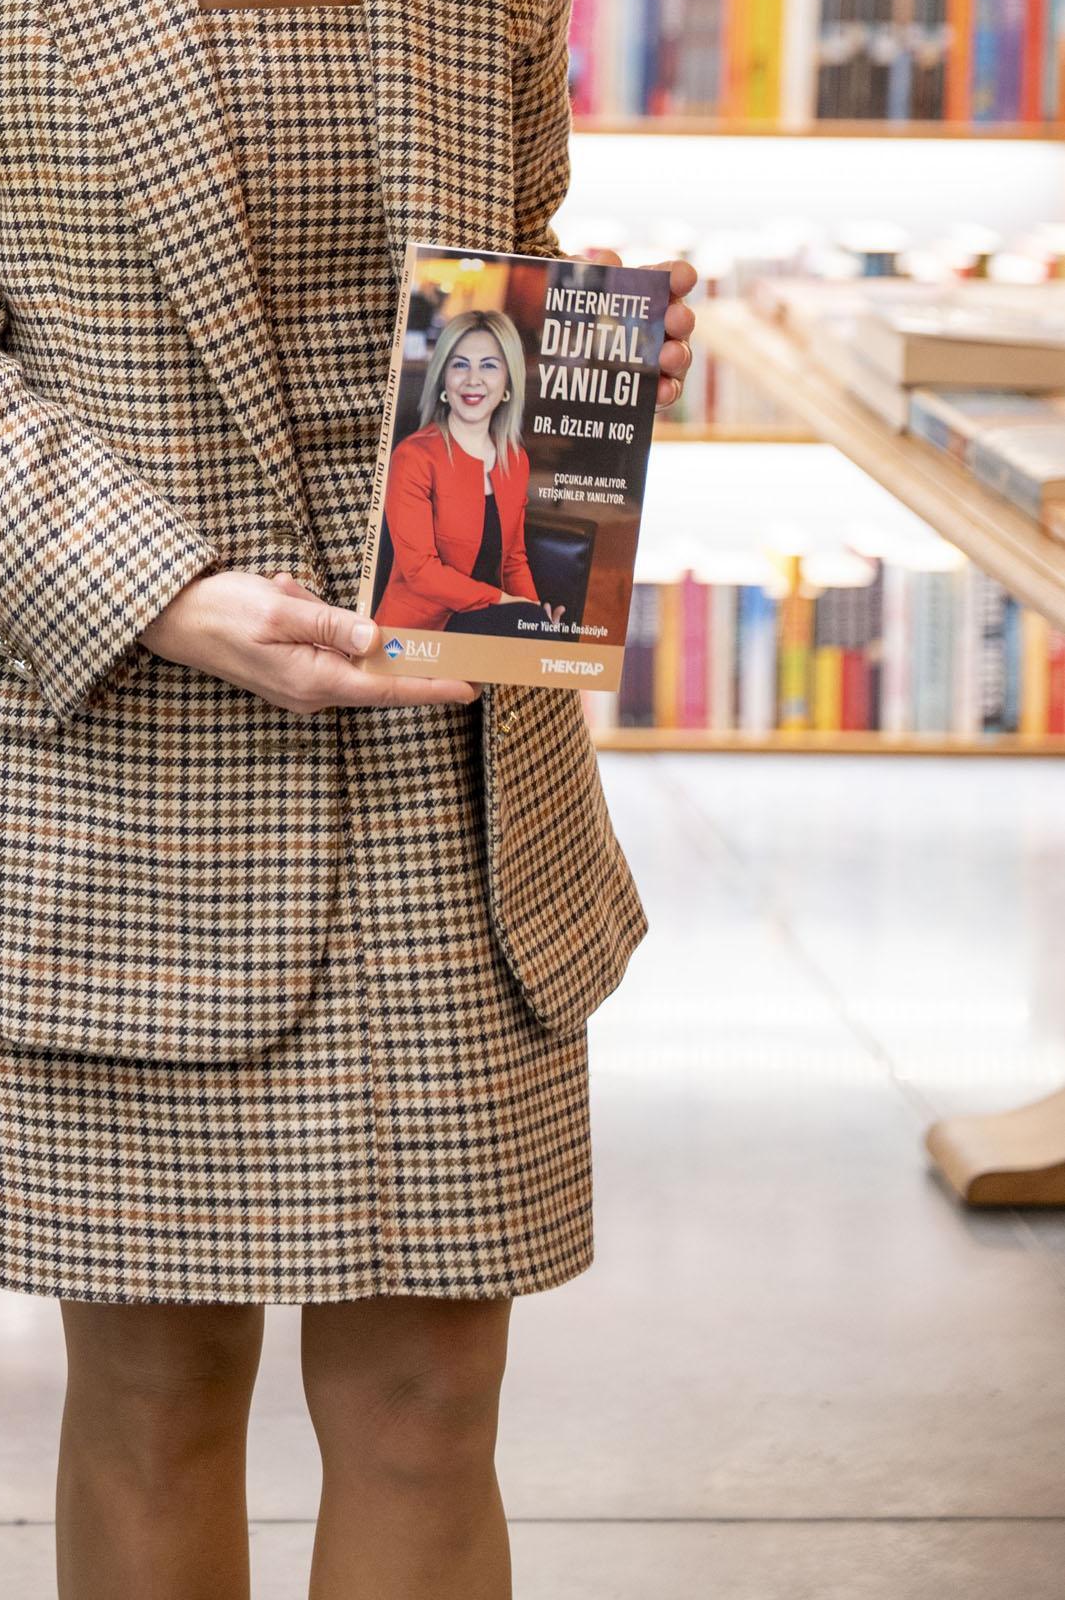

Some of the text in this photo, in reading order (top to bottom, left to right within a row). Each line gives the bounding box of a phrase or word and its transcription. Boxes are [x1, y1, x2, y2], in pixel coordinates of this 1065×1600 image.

[538, 363, 641, 407] YANILGI
[533, 415, 635, 444] DR. ÖZLEM KOÇ
[554, 473, 628, 489] ÇOCUKLAR ANLIYOR.
[538, 487, 626, 505] YETİŞKİNLER YANILIYOR.
[363, 524, 377, 580] YANILGI
[517, 619, 609, 638] Enver Yücel'in Önsözüyle
[405, 639, 441, 658] BAU
